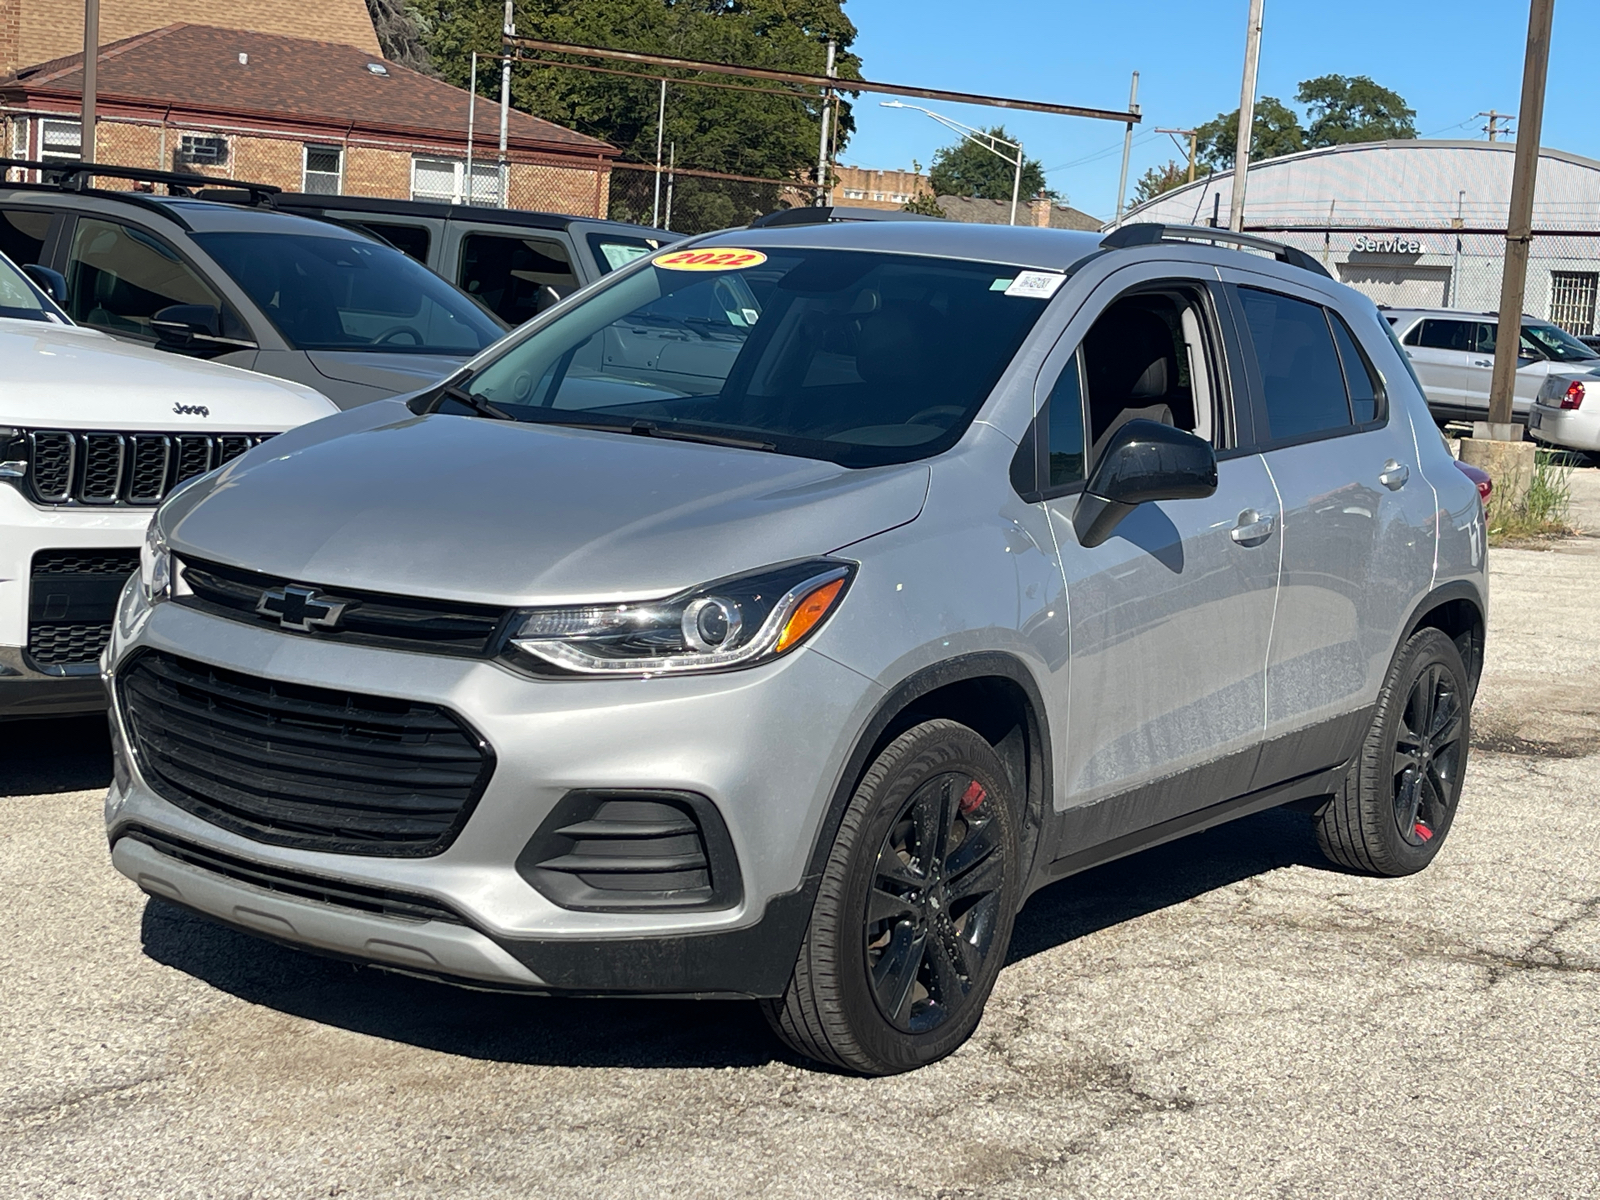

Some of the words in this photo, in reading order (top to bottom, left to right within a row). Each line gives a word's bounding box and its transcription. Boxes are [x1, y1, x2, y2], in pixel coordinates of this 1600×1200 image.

[1353, 236, 1420, 254] Service
[662, 252, 756, 266] 2022
[172, 401, 210, 418] Jeep
